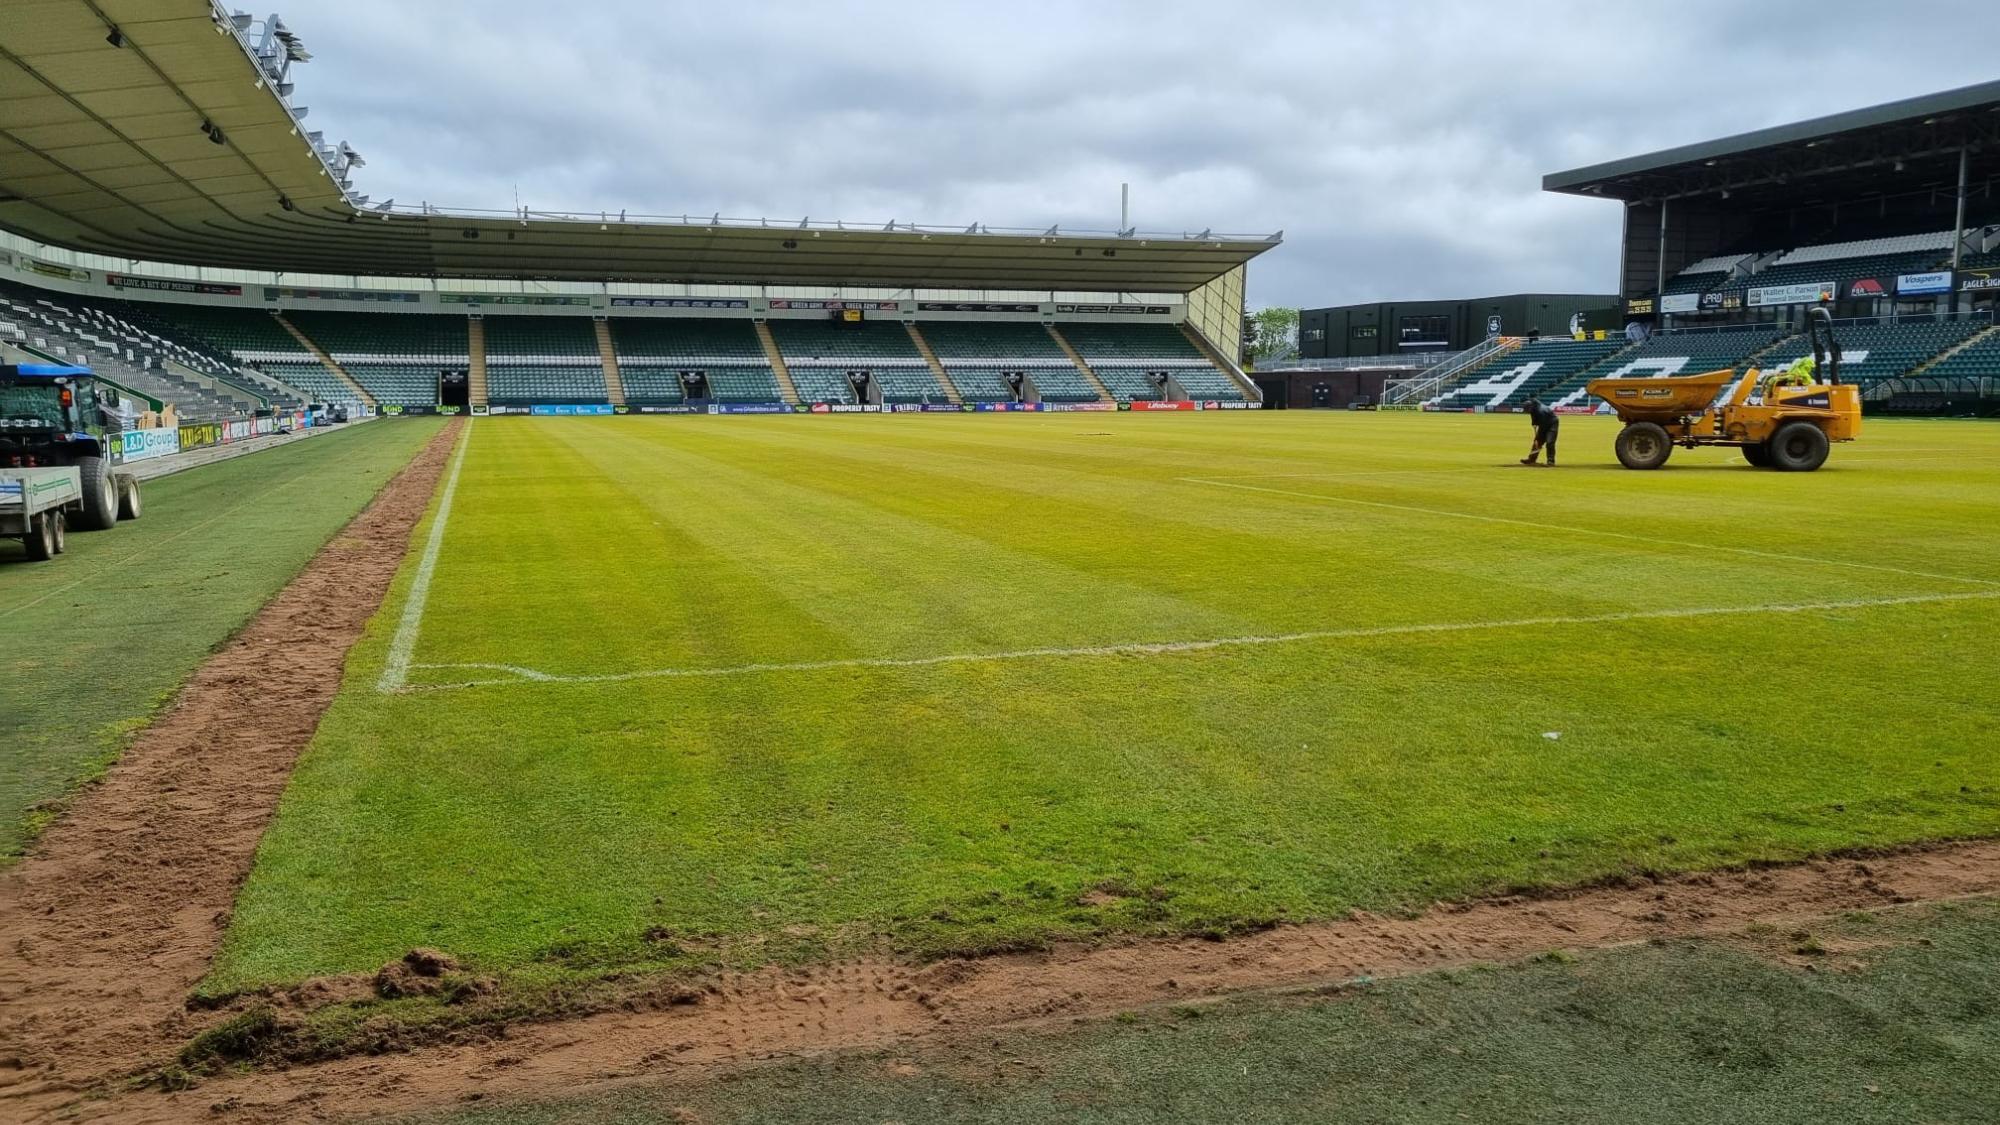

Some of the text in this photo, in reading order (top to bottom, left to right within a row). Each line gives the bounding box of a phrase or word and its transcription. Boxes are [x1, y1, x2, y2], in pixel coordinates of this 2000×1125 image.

[1963, 280, 1985, 288] EAGLE
[124, 432, 172, 452] L&D Group
